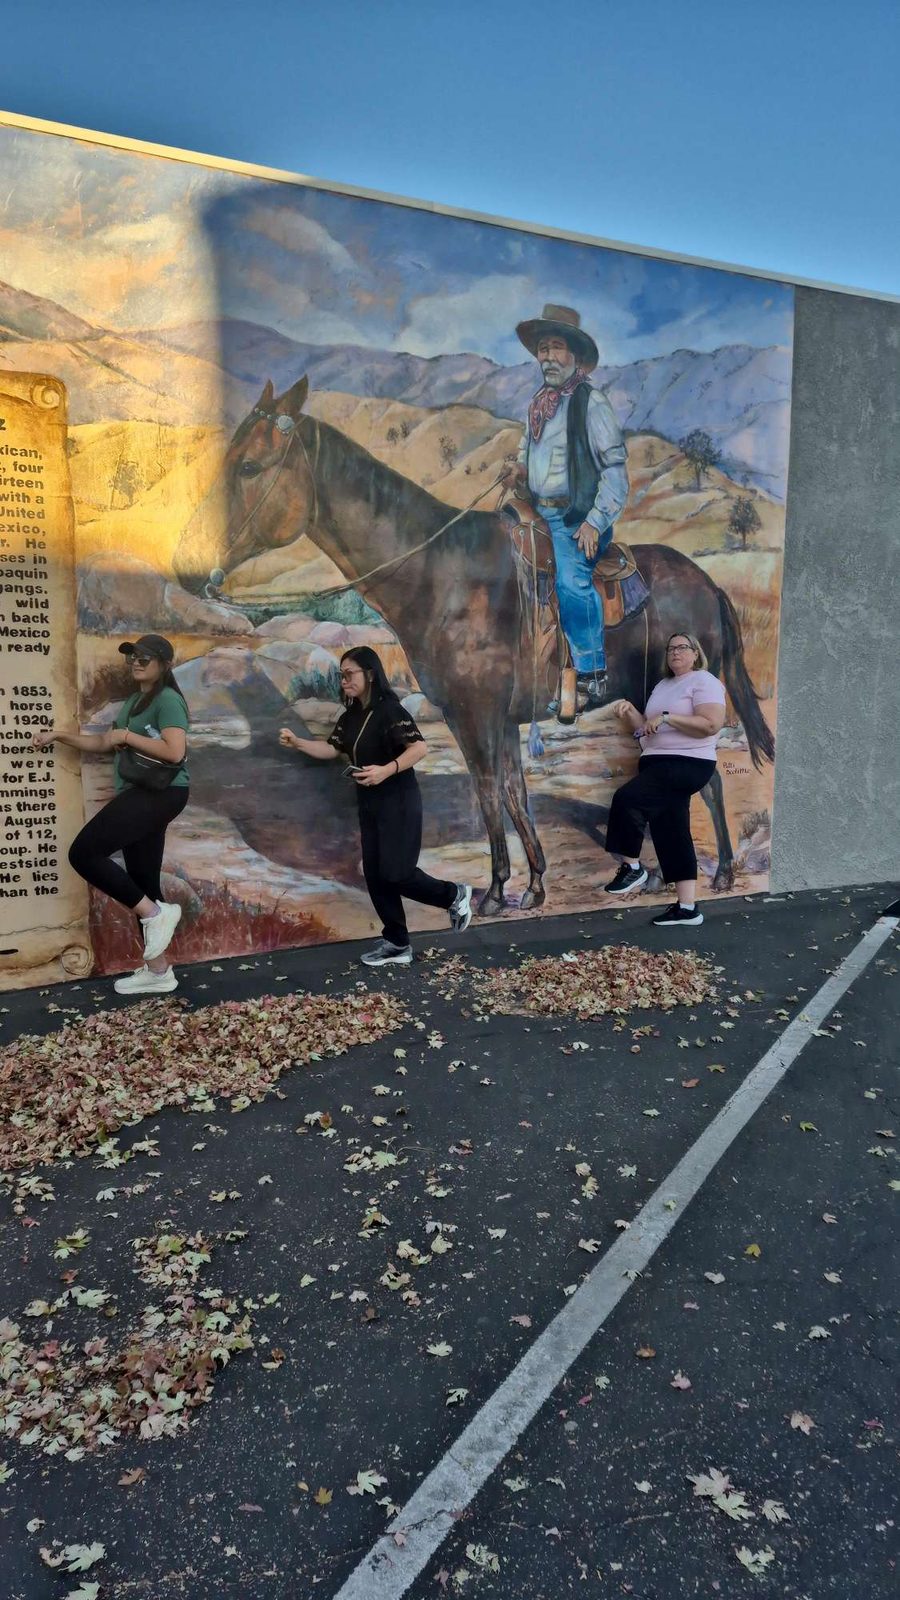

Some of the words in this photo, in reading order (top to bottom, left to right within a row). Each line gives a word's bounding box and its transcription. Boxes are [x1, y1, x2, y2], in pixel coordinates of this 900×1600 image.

[13, 461, 44, 474] four
[0, 491, 30, 503] with
[36, 496, 44, 504] a
[26, 538, 46, 549] He
[33, 554, 47, 565] in
[16, 598, 49, 609] wild
[12, 612, 49, 624] back
[0, 626, 50, 638] Mexico
[8, 642, 50, 656] ready
[12, 686, 52, 698] 1853,
[10, 701, 52, 711] horse
[40, 744, 54, 754] of
[11, 760, 54, 768] were
[2, 773, 24, 783] for
[28, 772, 54, 782] E.J.
[16, 802, 56, 812] there
[4, 815, 57, 828] August
[6, 830, 20, 841] of
[28, 830, 57, 840] 112,
[38, 843, 57, 853] He
[0, 872, 20, 883] He
[32, 870, 58, 882] lies
[34, 886, 58, 896] the
